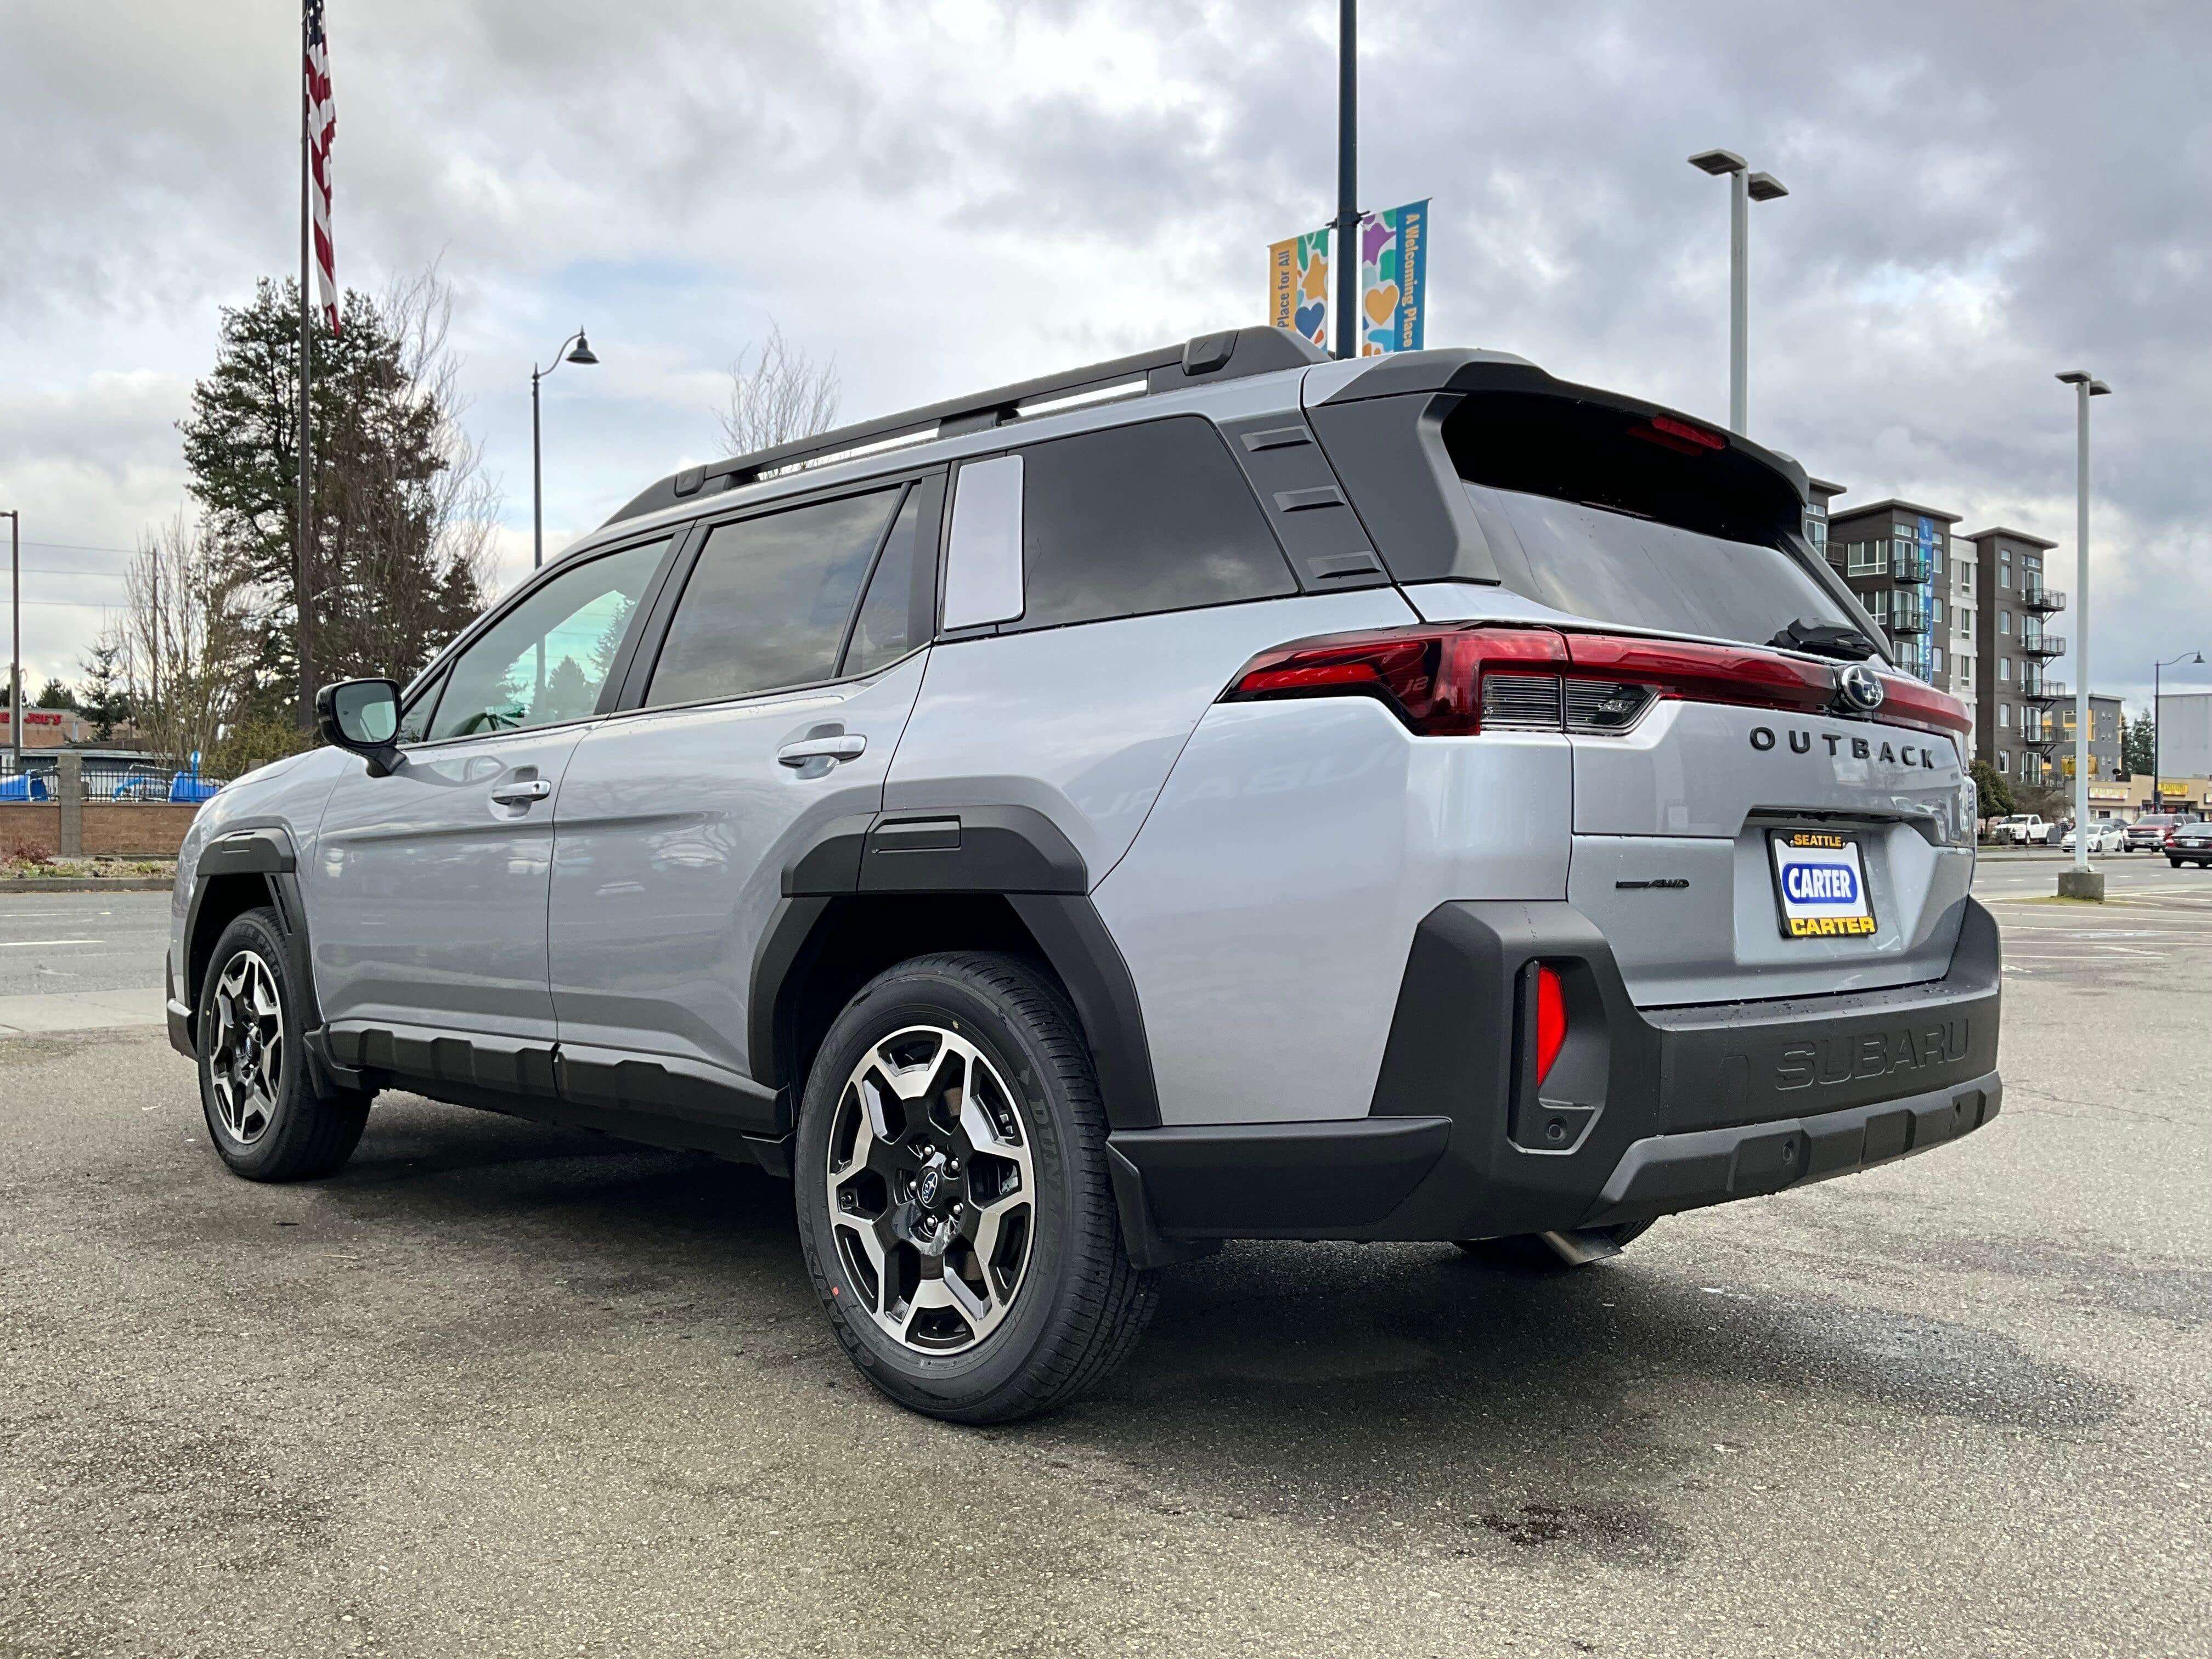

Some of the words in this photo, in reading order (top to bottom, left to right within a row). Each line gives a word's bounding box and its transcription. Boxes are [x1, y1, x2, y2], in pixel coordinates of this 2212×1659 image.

[1406, 214, 1420, 224] A
[1278, 250, 1289, 267] All
[1402, 224, 1419, 307] Welcoming
[1278, 271, 1289, 290] for
[1277, 292, 1289, 328] Place
[1403, 307, 1417, 348] Place
[1750, 727, 1934, 769] OUTBACK
[1793, 834, 1842, 847] SEATTLE
[1788, 867, 1852, 898] CARTER
[1790, 917, 1876, 935] CARTER
[1774, 1018, 1970, 1091] SUBARU
